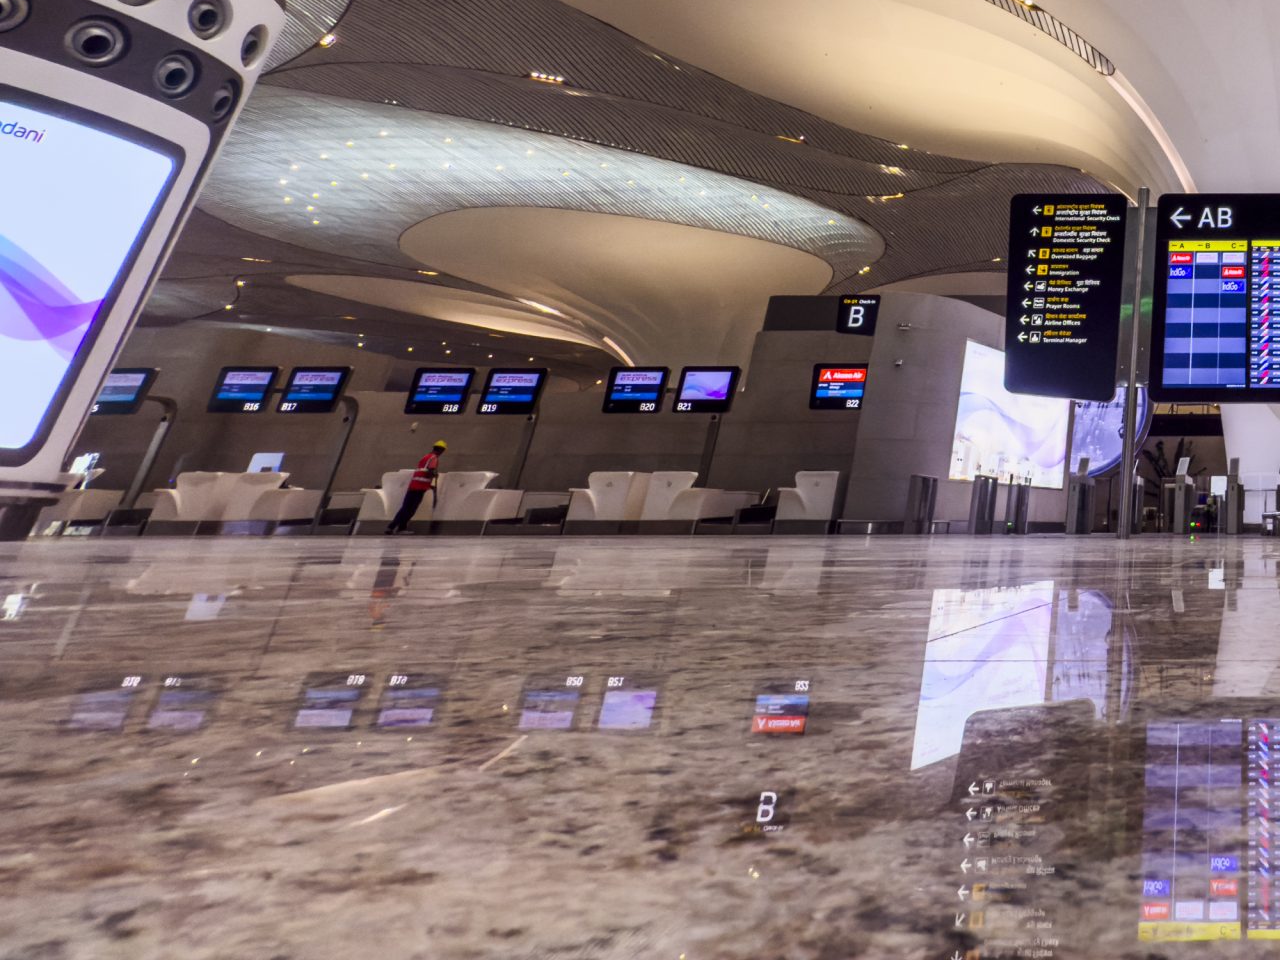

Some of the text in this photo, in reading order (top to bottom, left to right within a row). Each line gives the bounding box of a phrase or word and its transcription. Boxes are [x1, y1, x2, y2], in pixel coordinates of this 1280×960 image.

[0, 121, 46, 143] dani
[1198, 207, 1233, 228] AB
[848, 306, 865, 327] B
[243, 402, 260, 411] B16
[281, 402, 297, 411] B17
[639, 403, 655, 411] B20
[677, 403, 692, 411] B21
[846, 399, 859, 407] B22
[442, 404, 459, 412] B18
[481, 404, 497, 412] B19
